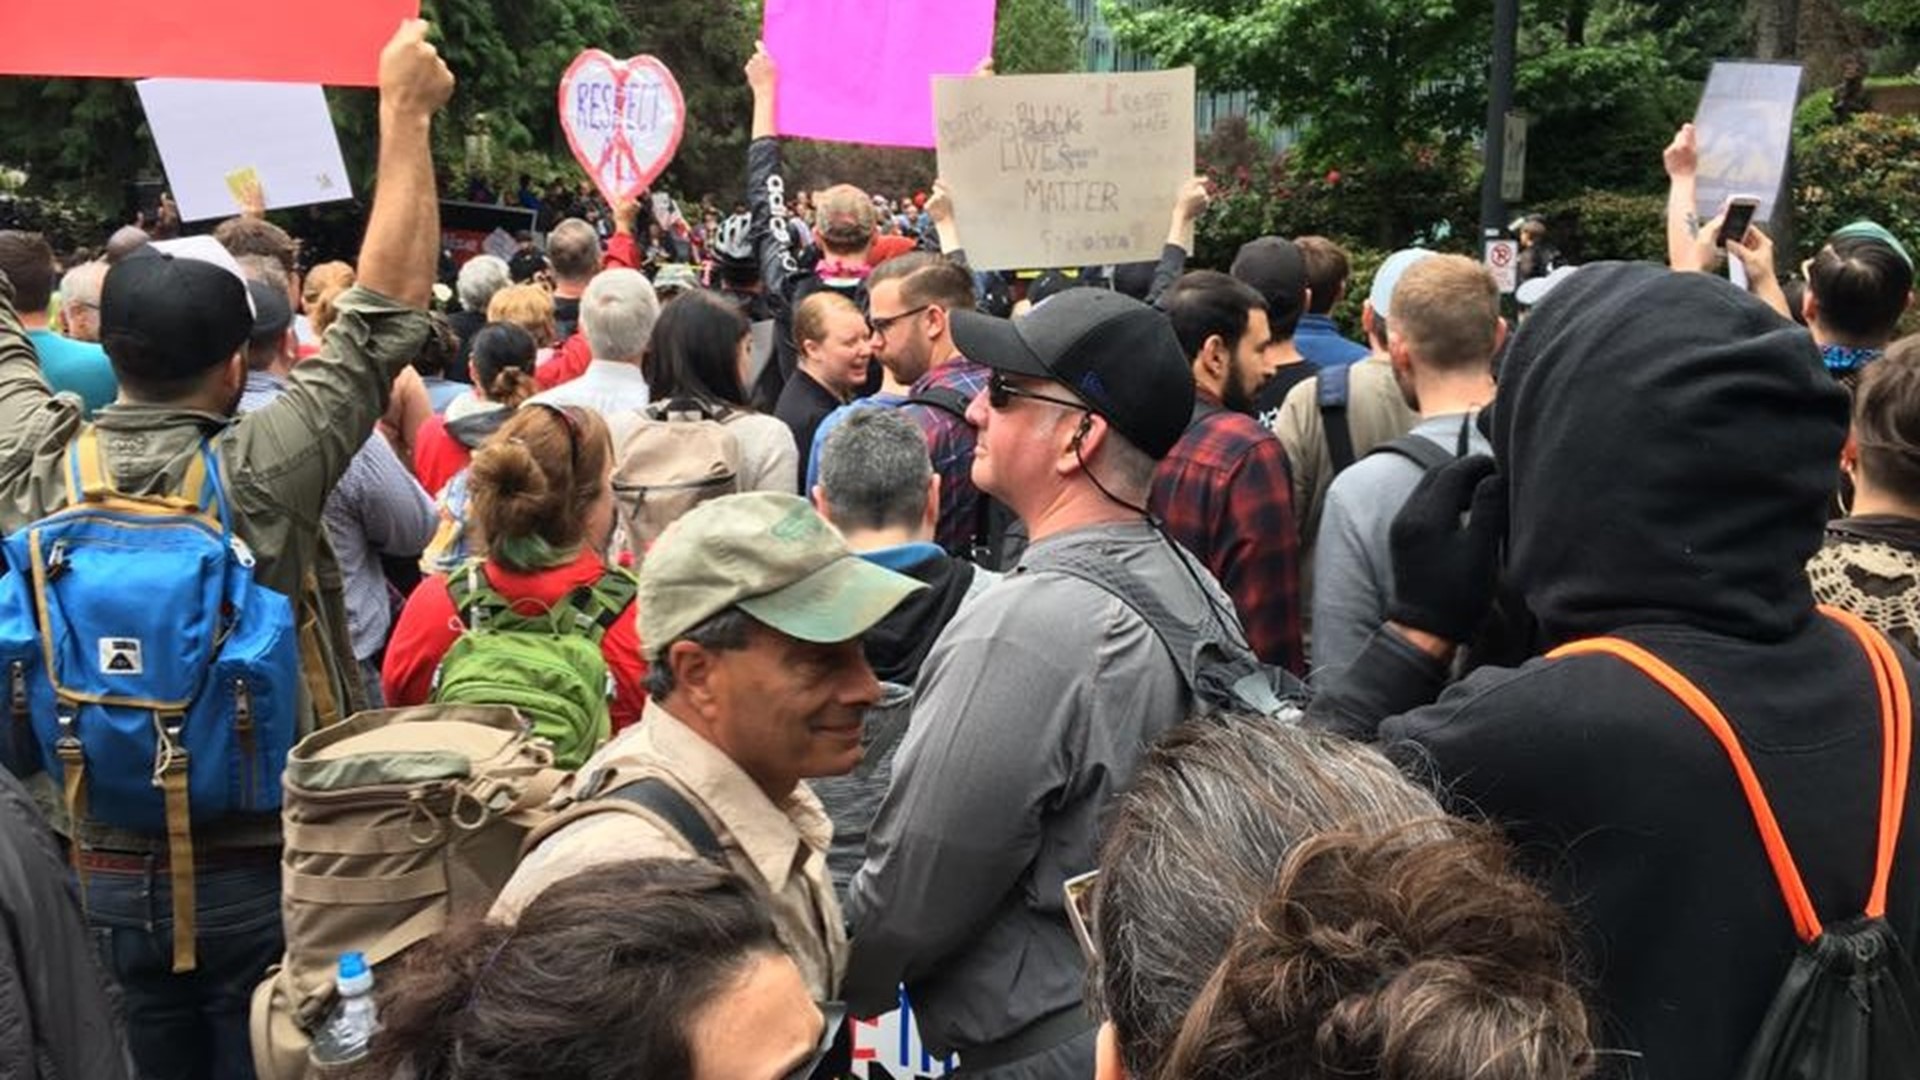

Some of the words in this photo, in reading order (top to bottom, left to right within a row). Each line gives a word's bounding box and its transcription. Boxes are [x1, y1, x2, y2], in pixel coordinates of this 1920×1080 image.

[577, 82, 662, 131] RESPECT
[1015, 101, 1083, 136] BLACK
[1000, 141, 1075, 174] LIVES
[1023, 179, 1120, 212] MATTER
